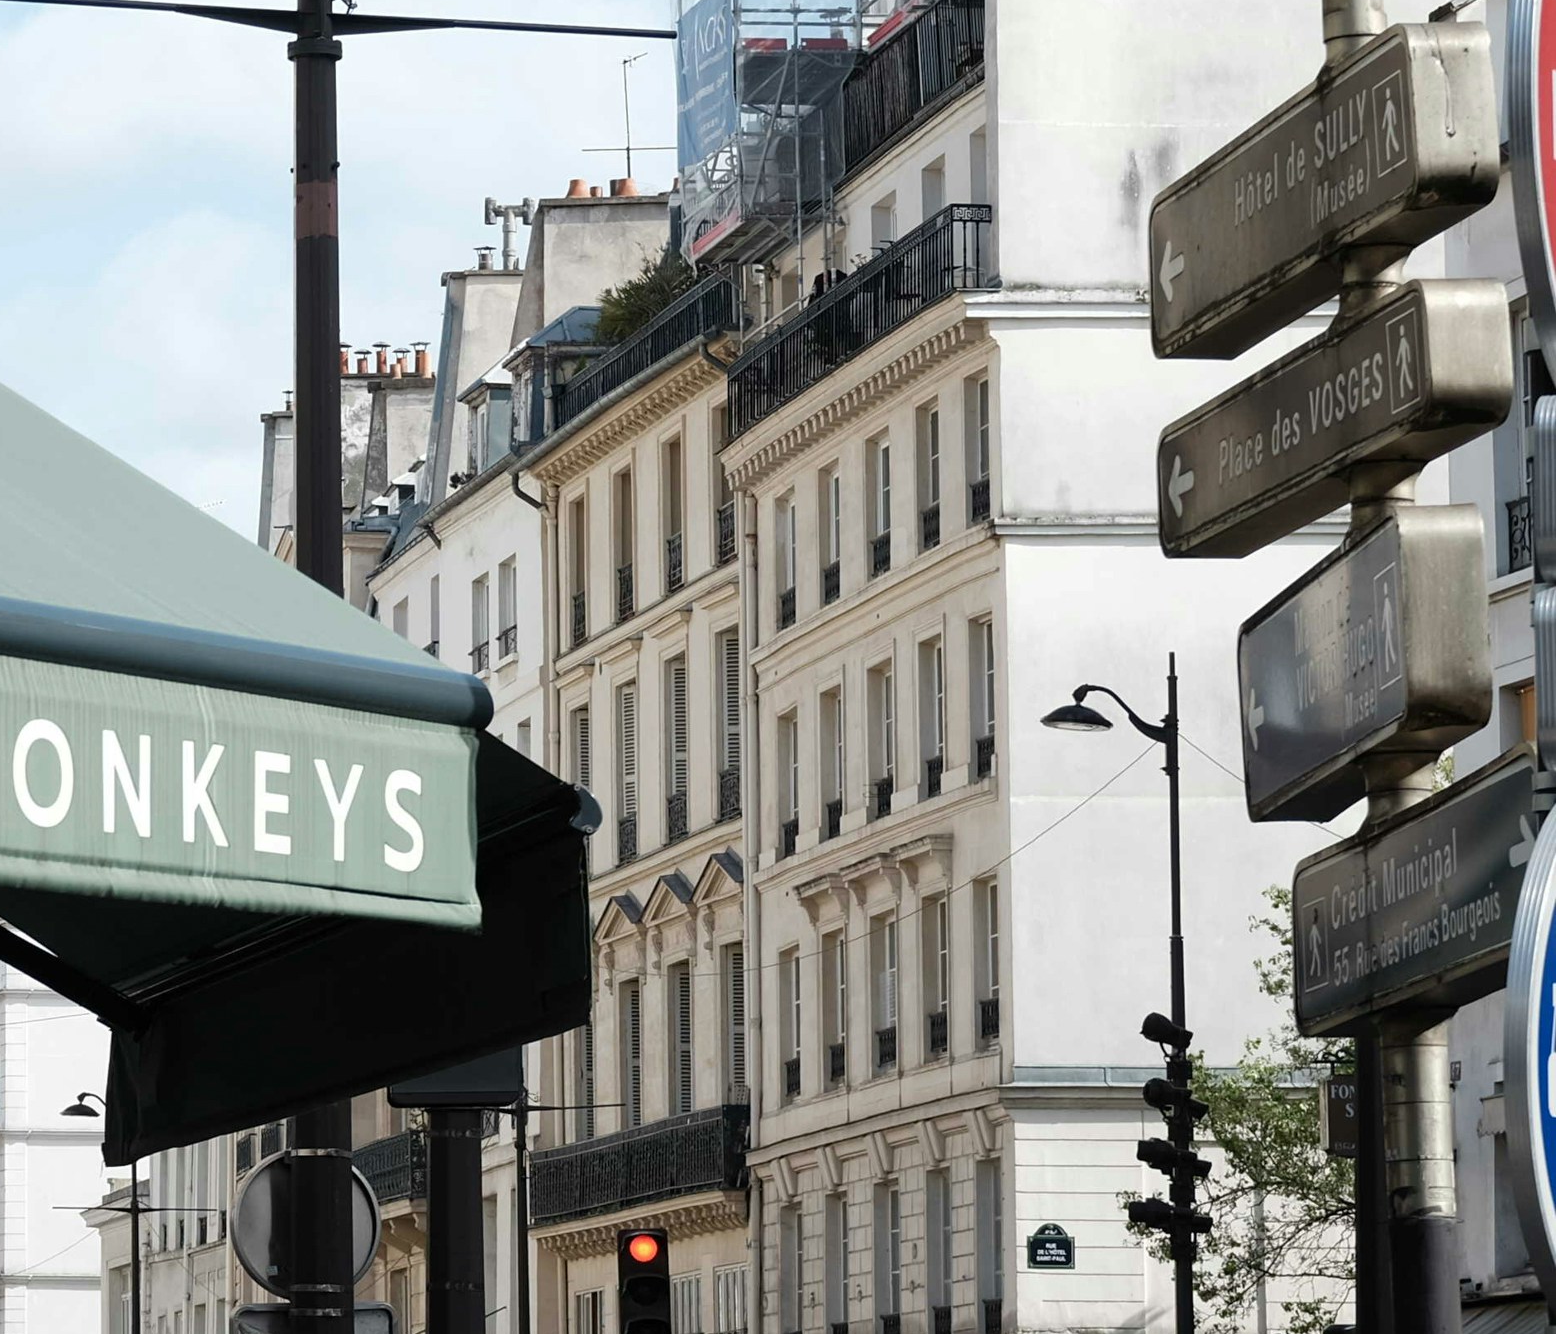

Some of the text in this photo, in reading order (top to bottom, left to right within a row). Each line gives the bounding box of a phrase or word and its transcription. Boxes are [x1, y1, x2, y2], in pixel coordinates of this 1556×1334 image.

[1234, 89, 1367, 227] Hôtel de SULLY
[1310, 138, 1370, 229] (Musée)
[1218, 352, 1383, 484] Place des VOSGES
[1331, 827, 1457, 930] Crédit Municipal
[1356, 941, 1378, 978] Rue
[1380, 934, 1399, 968] des
[1402, 916, 1440, 958] Francs
[1441, 881, 1501, 942] Bourgeois
